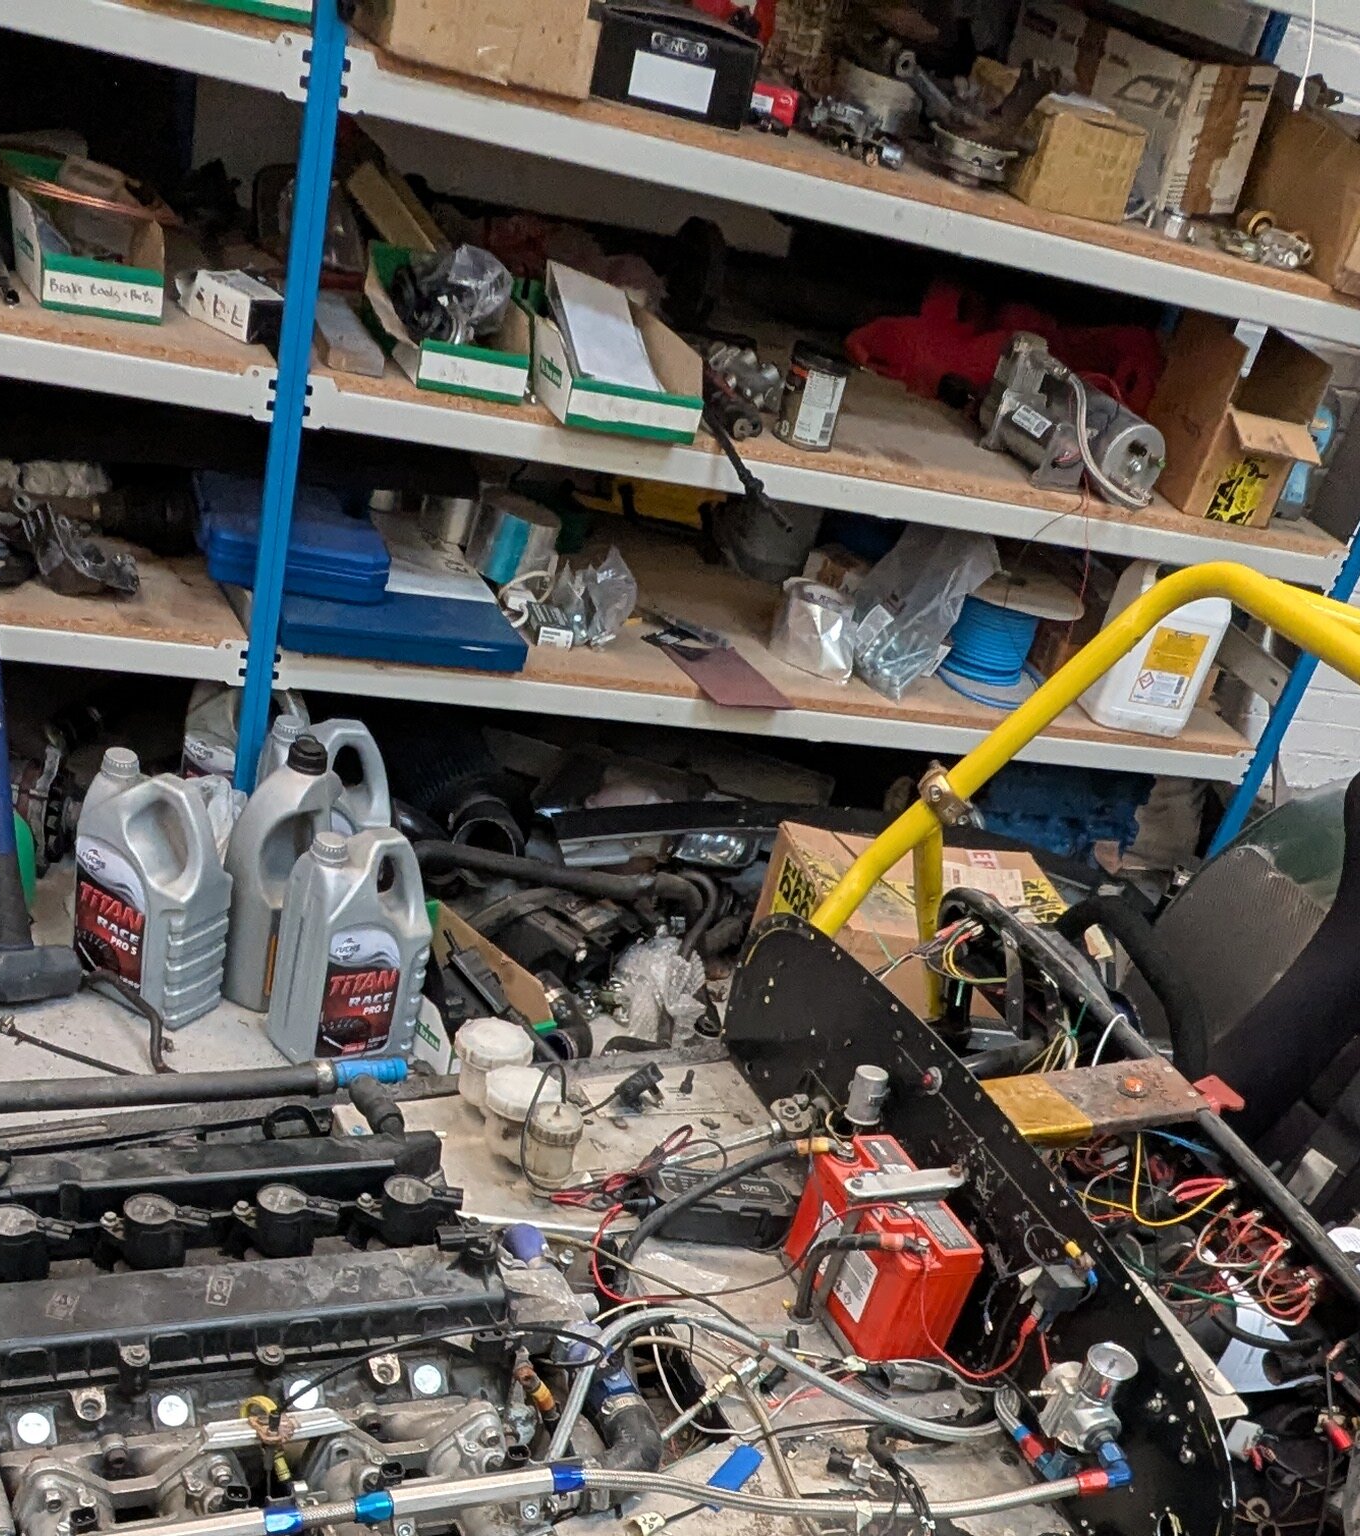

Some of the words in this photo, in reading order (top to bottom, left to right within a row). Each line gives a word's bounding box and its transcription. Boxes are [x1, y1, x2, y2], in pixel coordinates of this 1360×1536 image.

[96, 915, 140, 944] RACE
[110, 936, 129, 951] PRO
[335, 942, 361, 954] FUCHS
[348, 991, 393, 1007] RACE
[362, 1005, 382, 1016] PRO
